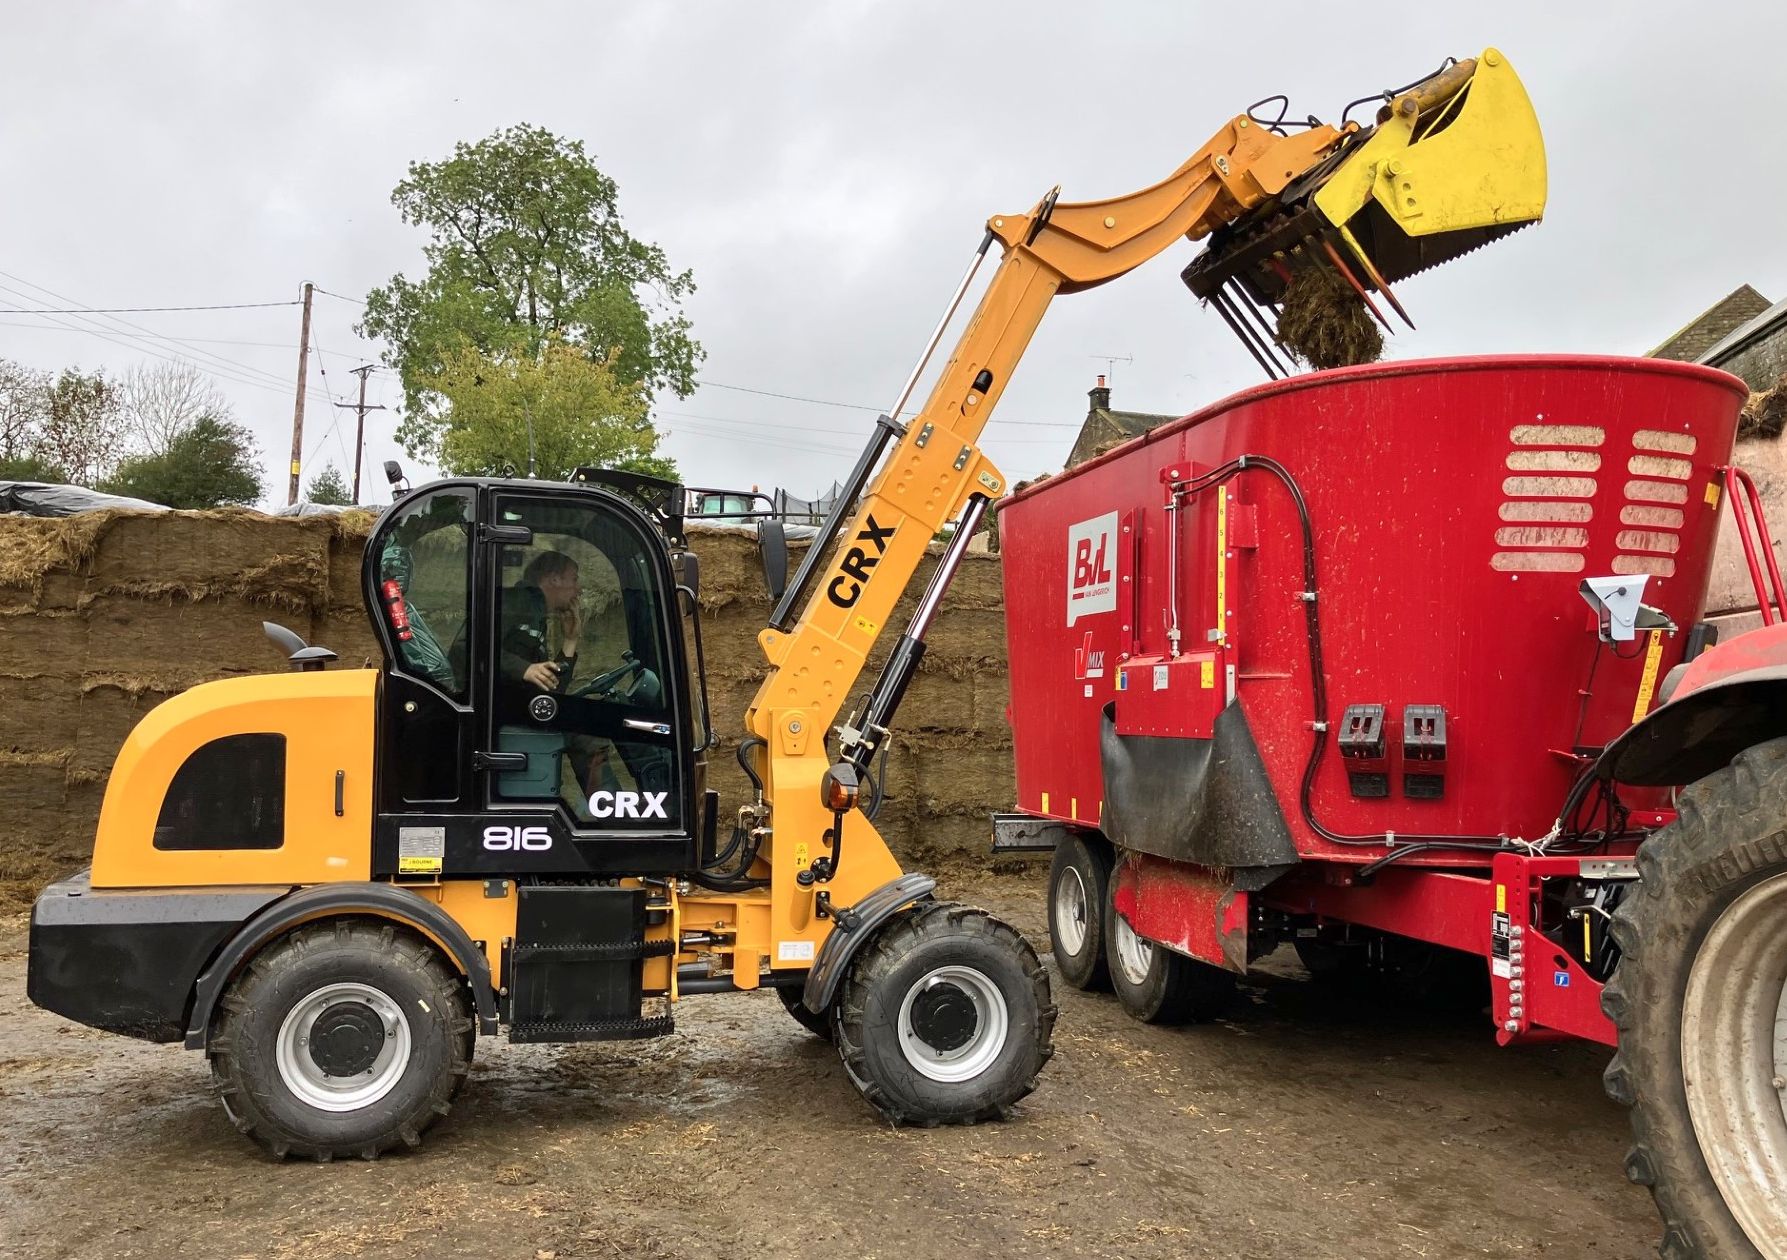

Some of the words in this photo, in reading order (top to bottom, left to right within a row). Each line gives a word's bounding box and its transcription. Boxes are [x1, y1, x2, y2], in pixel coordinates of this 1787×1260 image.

[827, 513, 897, 609] CRX
[588, 790, 668, 819] CRX
[483, 826, 553, 851] 816
